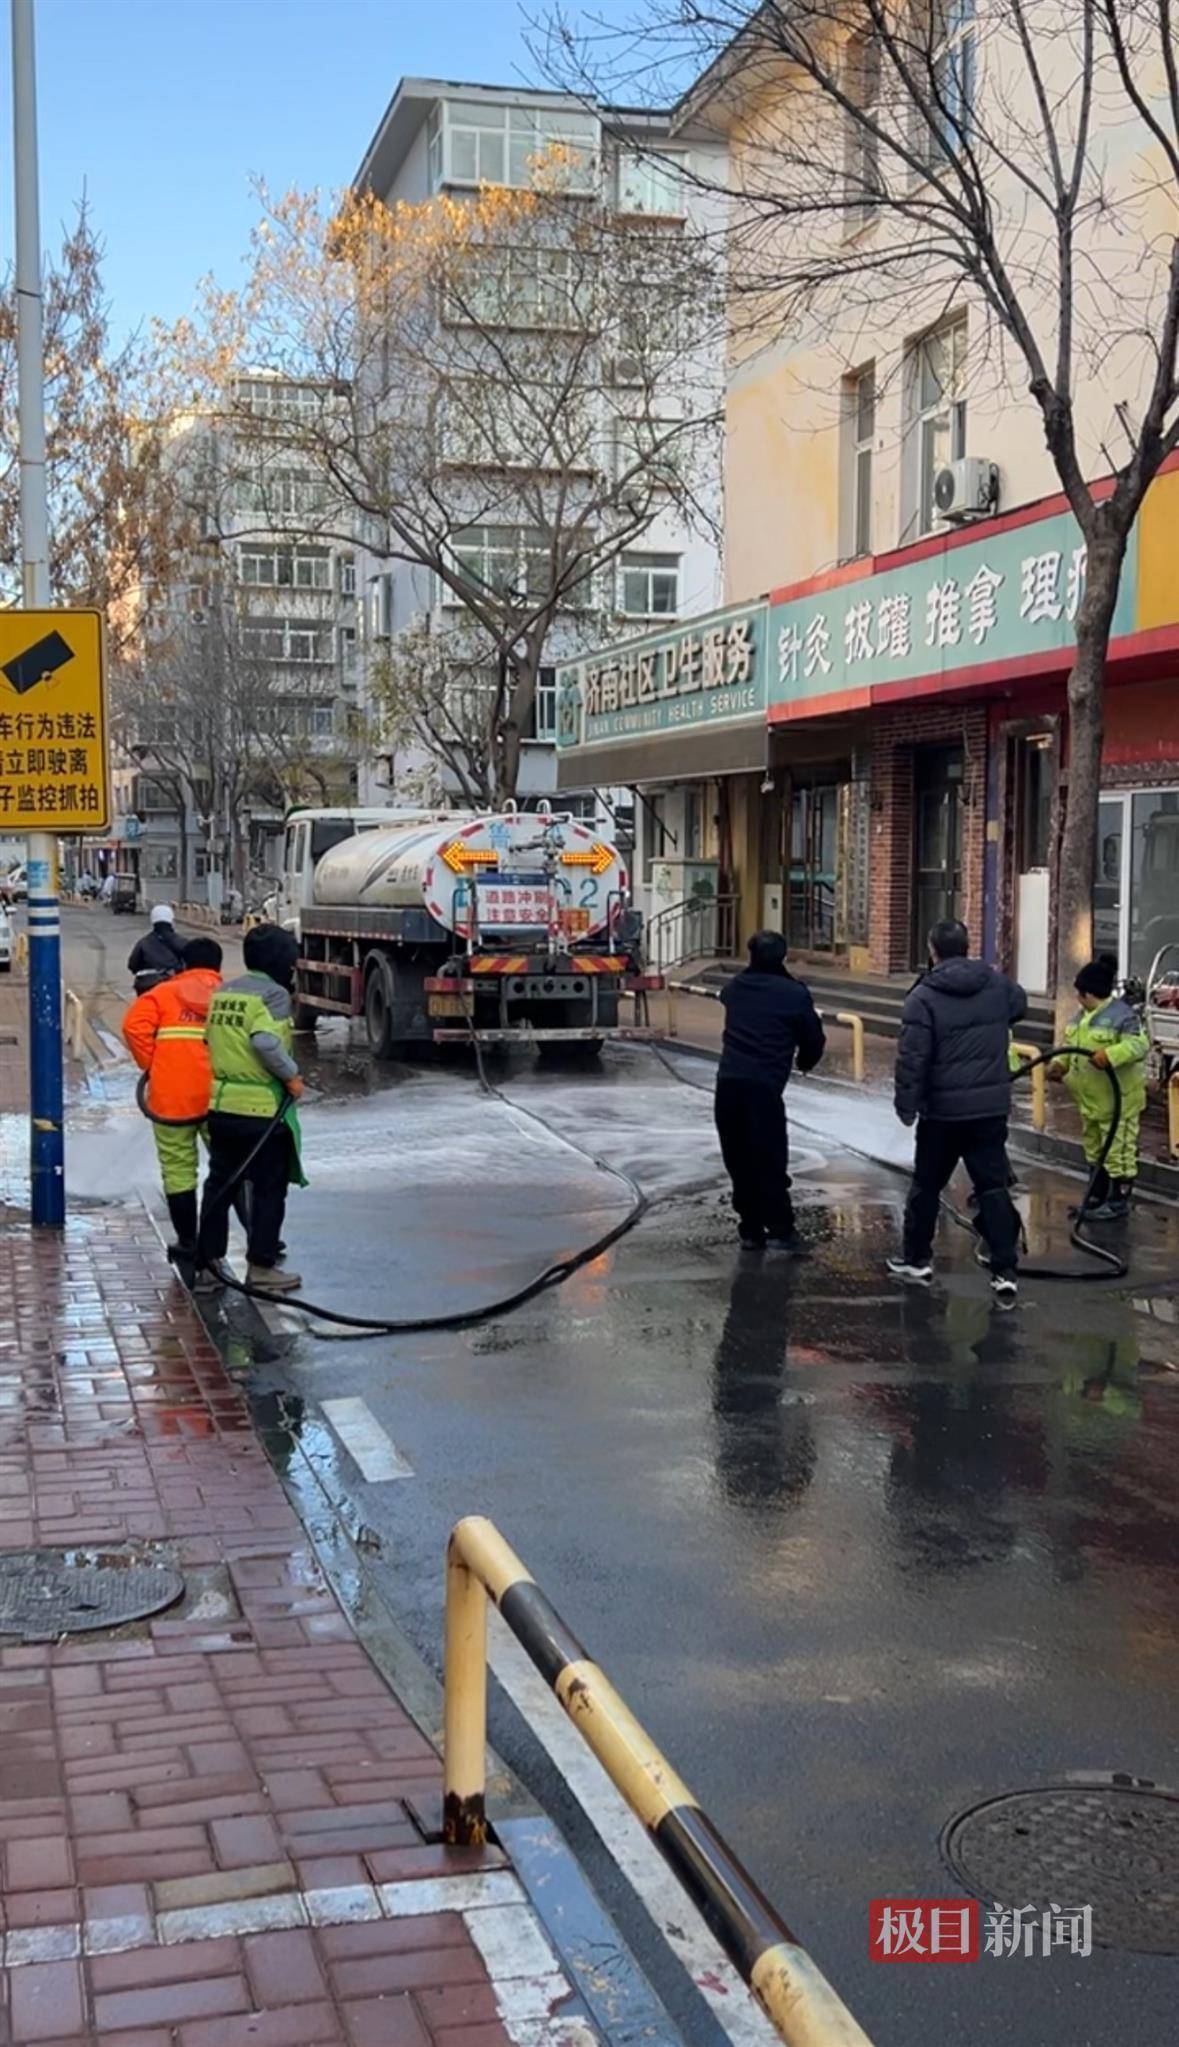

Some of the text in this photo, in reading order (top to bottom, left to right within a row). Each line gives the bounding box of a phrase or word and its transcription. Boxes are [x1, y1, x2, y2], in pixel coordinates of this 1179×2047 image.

[777, 613, 832, 683] 针灸
[844, 596, 912, 664] 拔罐
[926, 563, 1004, 648] 推拿
[585, 619, 754, 716] 济南社区卫生服务
[668, 701, 703, 723] HEALTH
[711, 688, 755, 715] SERVICE
[0, 712, 96, 740] 车行为违法
[0, 747, 88, 776] 立即驶离
[0, 783, 98, 811] 子监控抓拍
